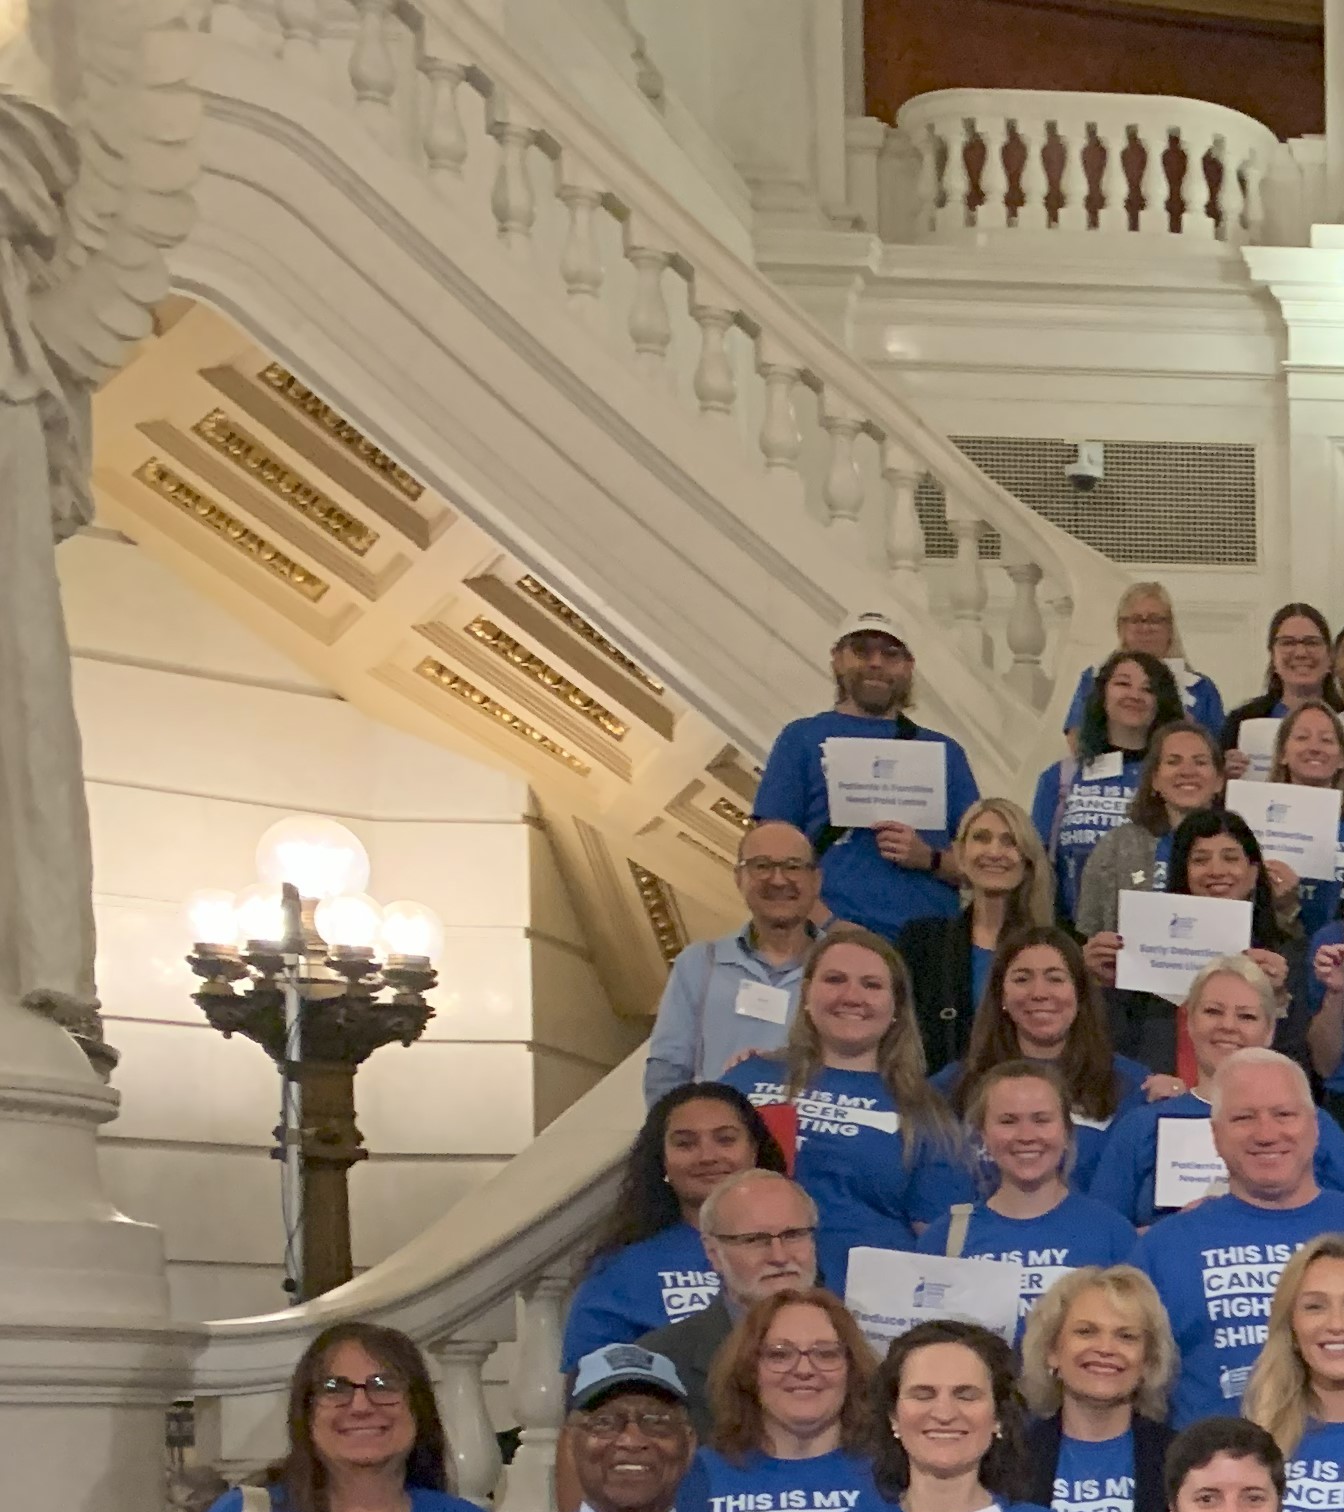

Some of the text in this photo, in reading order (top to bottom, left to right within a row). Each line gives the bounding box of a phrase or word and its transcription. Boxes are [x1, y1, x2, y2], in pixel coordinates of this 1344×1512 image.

[809, 1089, 879, 1111] IS MY
[1027, 1248, 1070, 1266] MY
[1200, 1243, 1292, 1267] THIS IS
[657, 1270, 721, 1288] THIS
[1312, 1460, 1339, 1481] IS
[778, 1490, 807, 1510] IS
[813, 1489, 861, 1508] MY
[1073, 1478, 1100, 1501] IS
